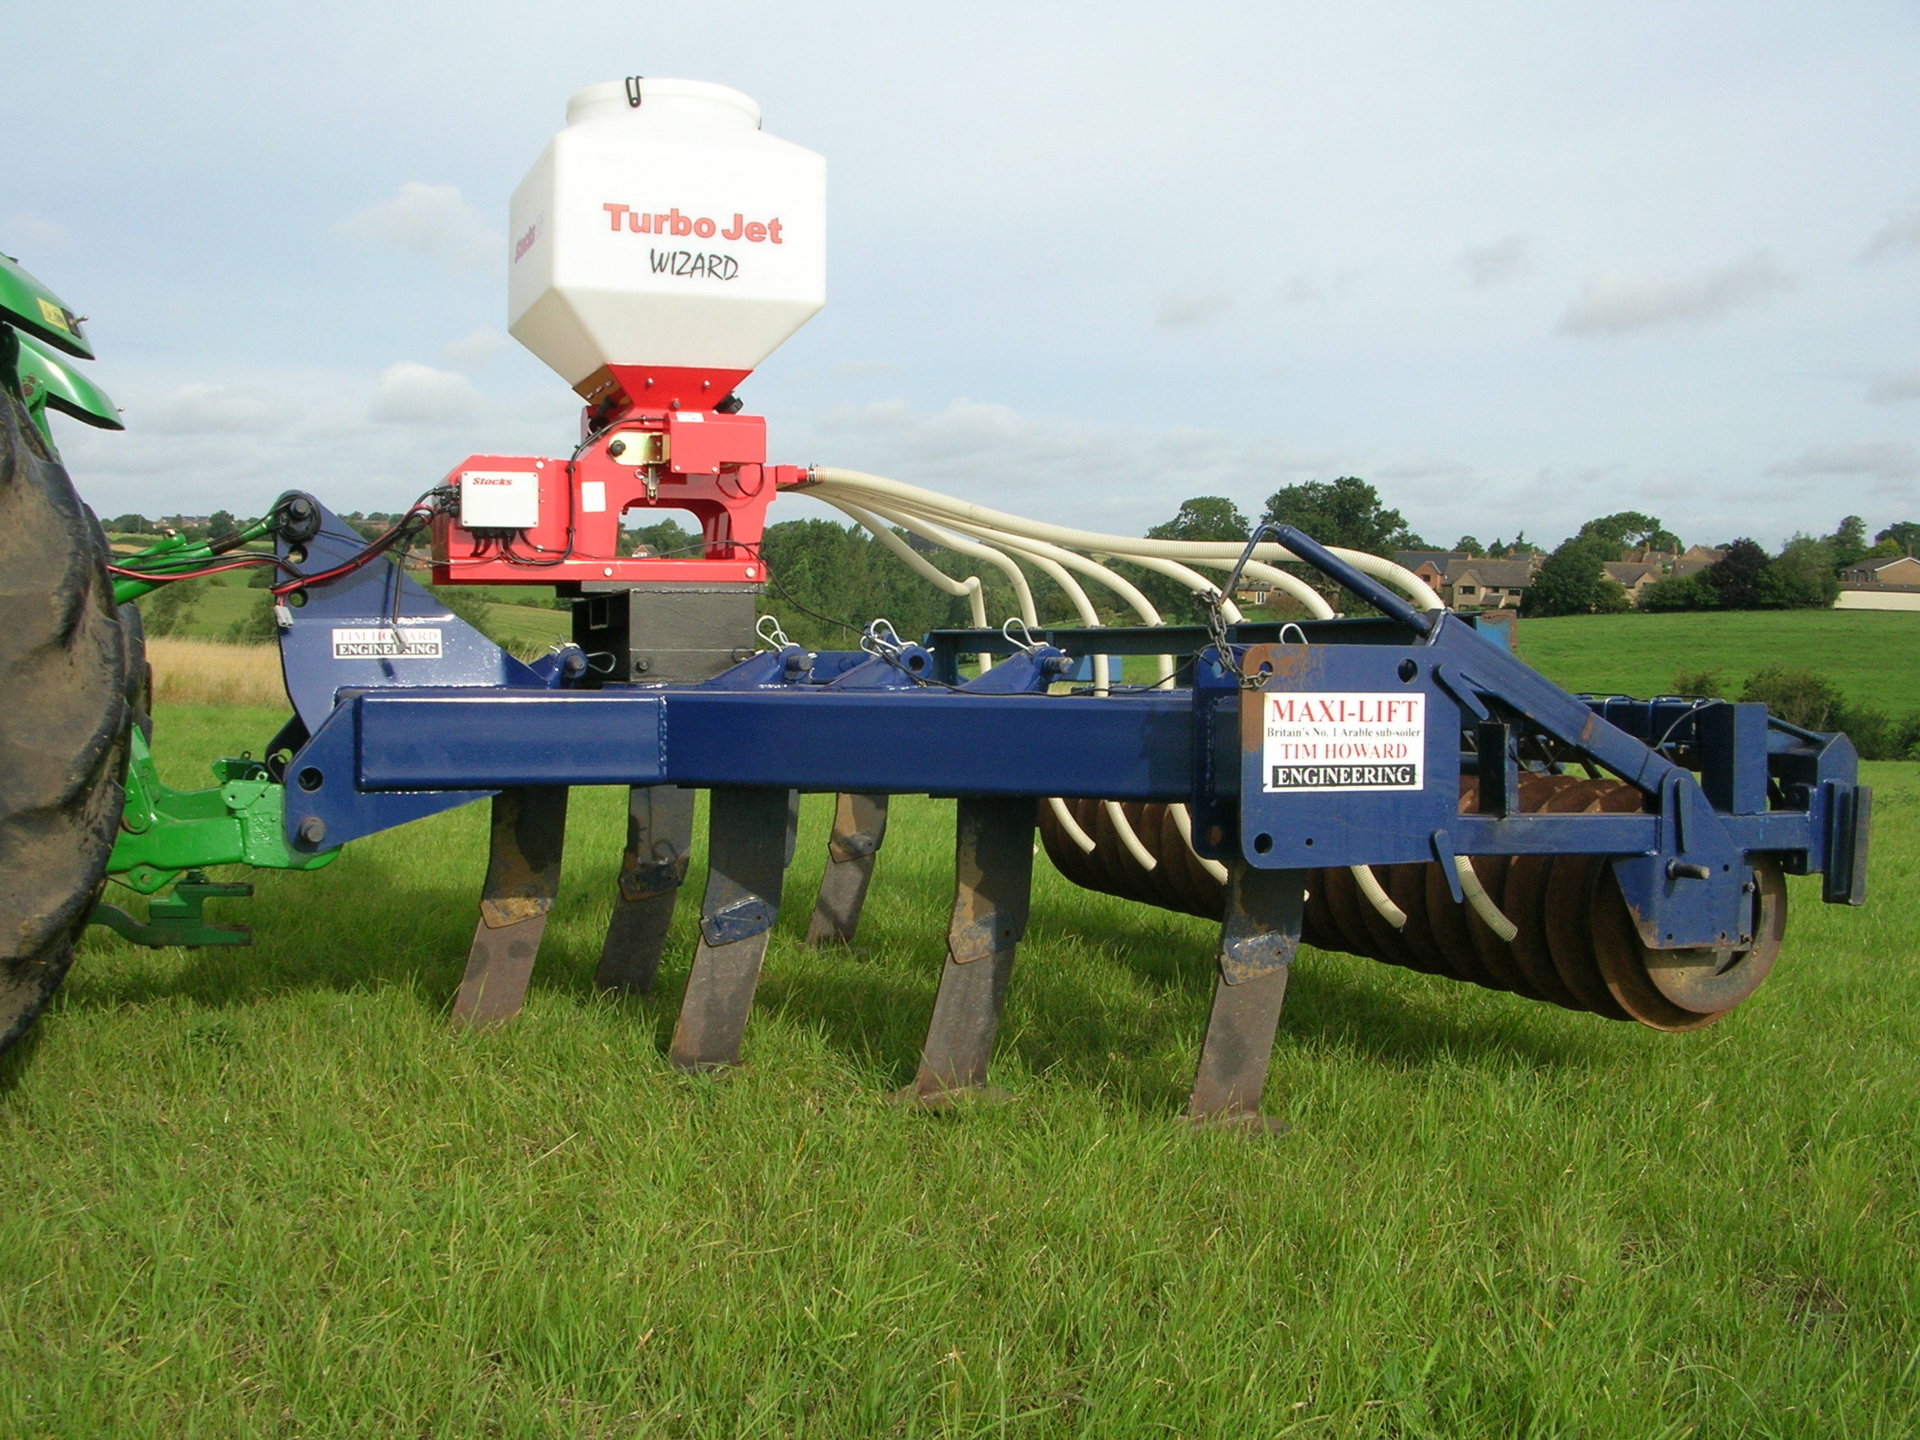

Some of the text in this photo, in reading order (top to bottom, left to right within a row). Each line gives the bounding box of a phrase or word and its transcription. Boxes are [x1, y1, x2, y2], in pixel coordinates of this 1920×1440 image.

[603, 203, 782, 244] Turbo Jet
[650, 248, 738, 280] WIZARD
[472, 477, 512, 485] Stocks
[371, 631, 438, 641] HOARD
[1272, 700, 1418, 722] MAXI-LIFT
[1267, 727, 1309, 737] Britain's
[1313, 727, 1329, 737] No.
[1341, 727, 1373, 737] Arable
[1375, 727, 1421, 738] sub-soiler
[1281, 743, 1408, 759] TIM HOWARD
[1277, 766, 1410, 785] ENGINEERING
